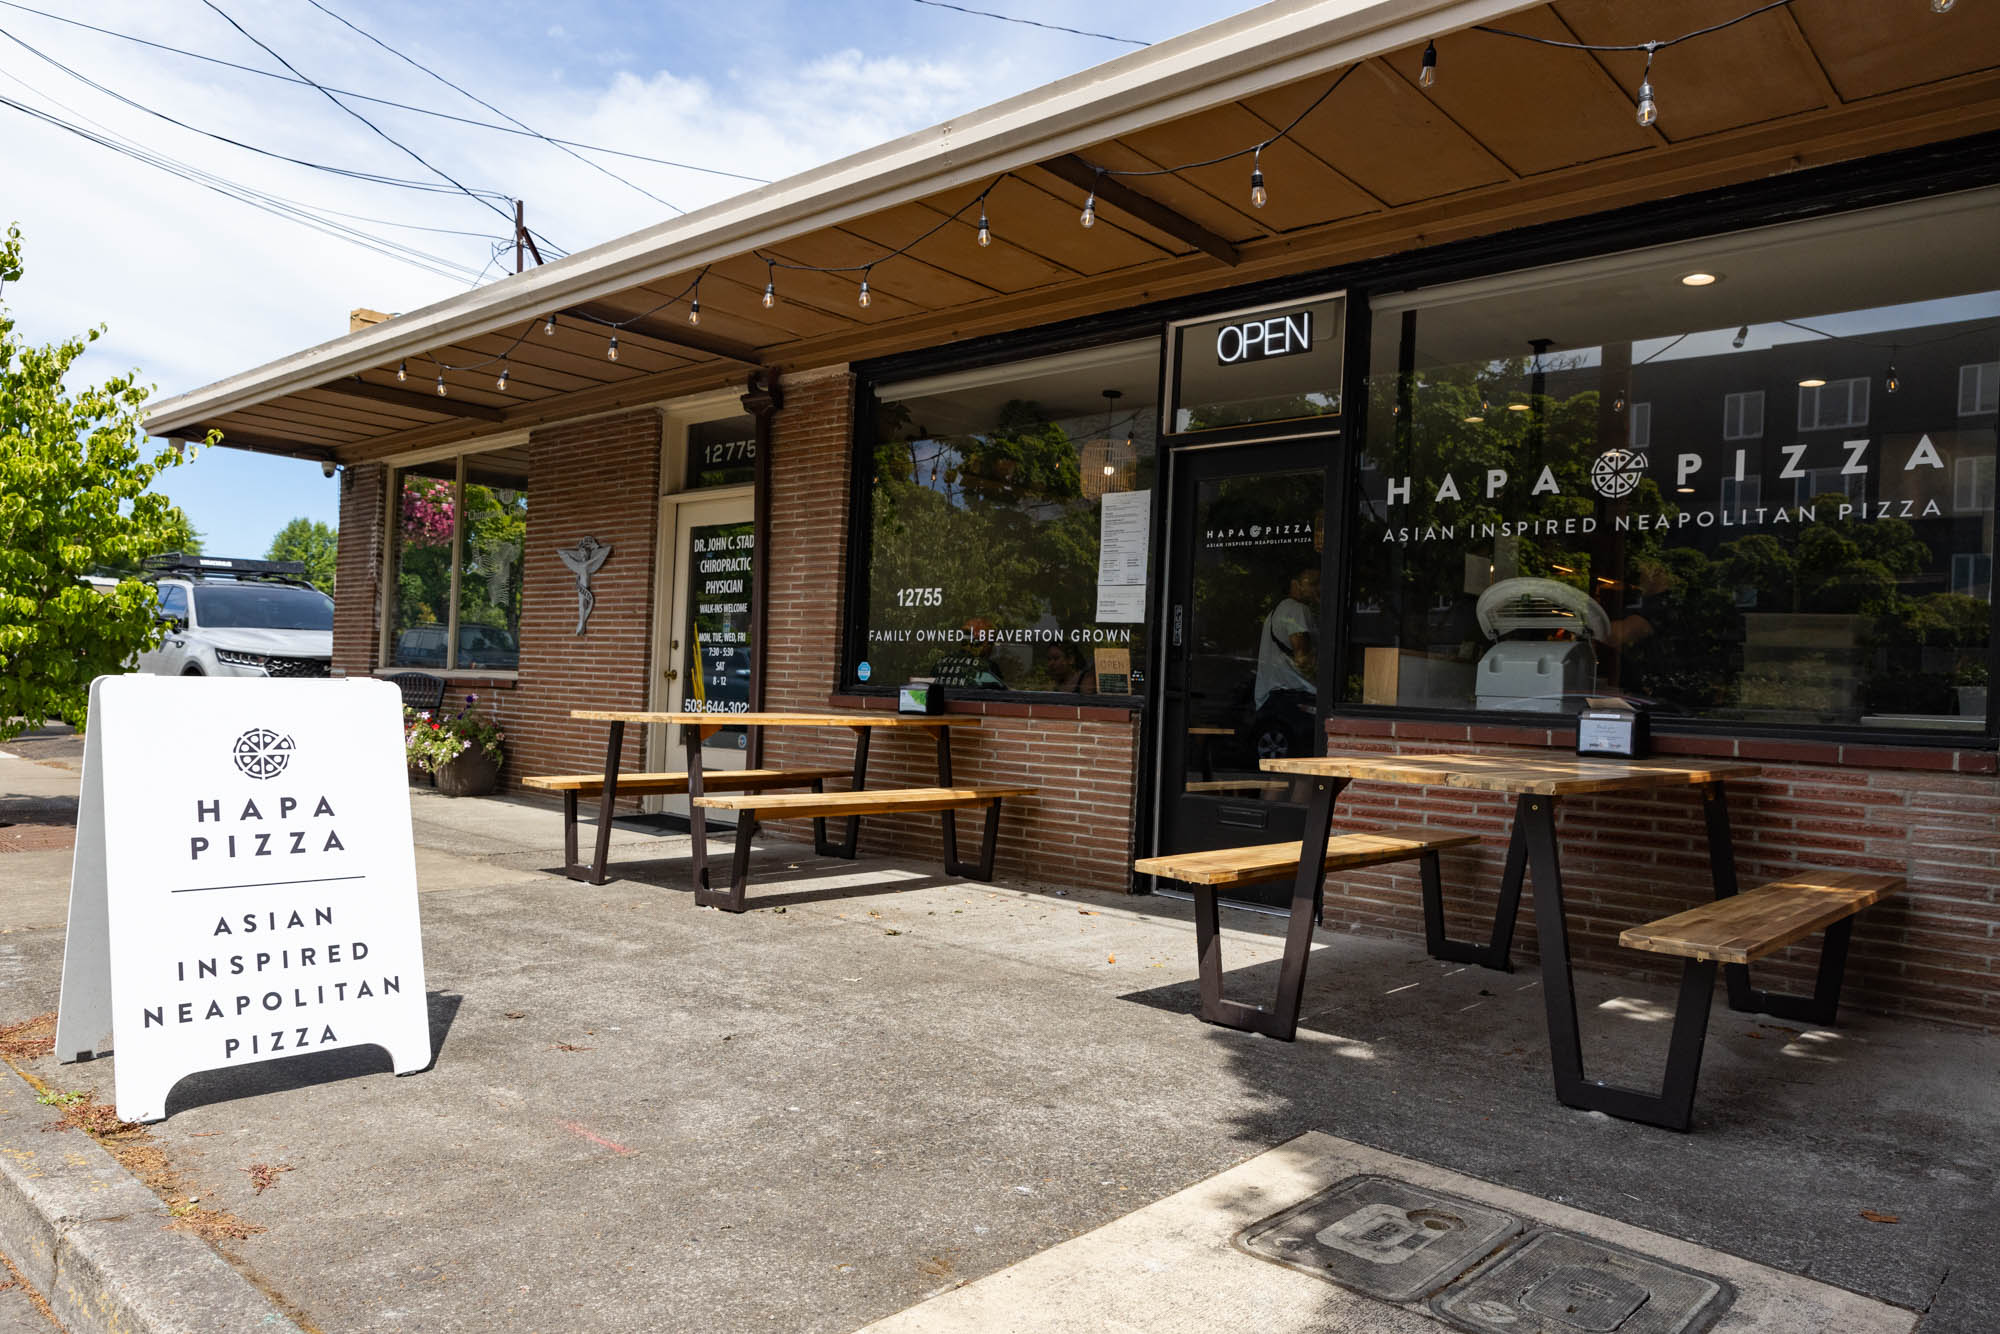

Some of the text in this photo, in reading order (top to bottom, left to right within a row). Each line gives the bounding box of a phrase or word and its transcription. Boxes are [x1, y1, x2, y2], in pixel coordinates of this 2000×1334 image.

[1217, 312, 1308, 362] OPEN
[705, 440, 756, 464] 12775
[1387, 434, 1945, 505] HAPA PIZZA
[1383, 499, 1942, 543] ASIAN INSPIRED NEAPOLITAN PIZZA
[1206, 524, 1312, 539] HAPA PIZZA
[694, 539, 706, 552] DR.
[707, 537, 727, 551] JOHN
[728, 536, 735, 549] C.
[700, 557, 751, 573] CHIROPRACTIC
[705, 579, 743, 594] PHYSICIAN
[897, 588, 942, 607] 12755
[700, 603, 748, 613] WALK-INS WELCOME
[699, 632, 746, 643] MON, TUE, WED, FRI
[869, 630, 911, 642] FAMILY
[916, 629, 964, 642] OWNED
[979, 629, 1063, 642] BEAVERTON
[1070, 629, 1131, 643] GROWN
[709, 647, 719, 656] 7:30
[715, 661, 725, 671] SAT
[713, 676, 717, 685] 8
[721, 676, 727, 685] 12
[685, 699, 749, 714] 503-644-302
[197, 795, 335, 822] HAPA
[190, 830, 345, 860] PIZZA
[214, 907, 332, 936] ASIAN
[178, 942, 369, 981] INSPIRED
[144, 976, 400, 1028] NEAPOLITAN
[225, 1024, 338, 1058] PIZZA
